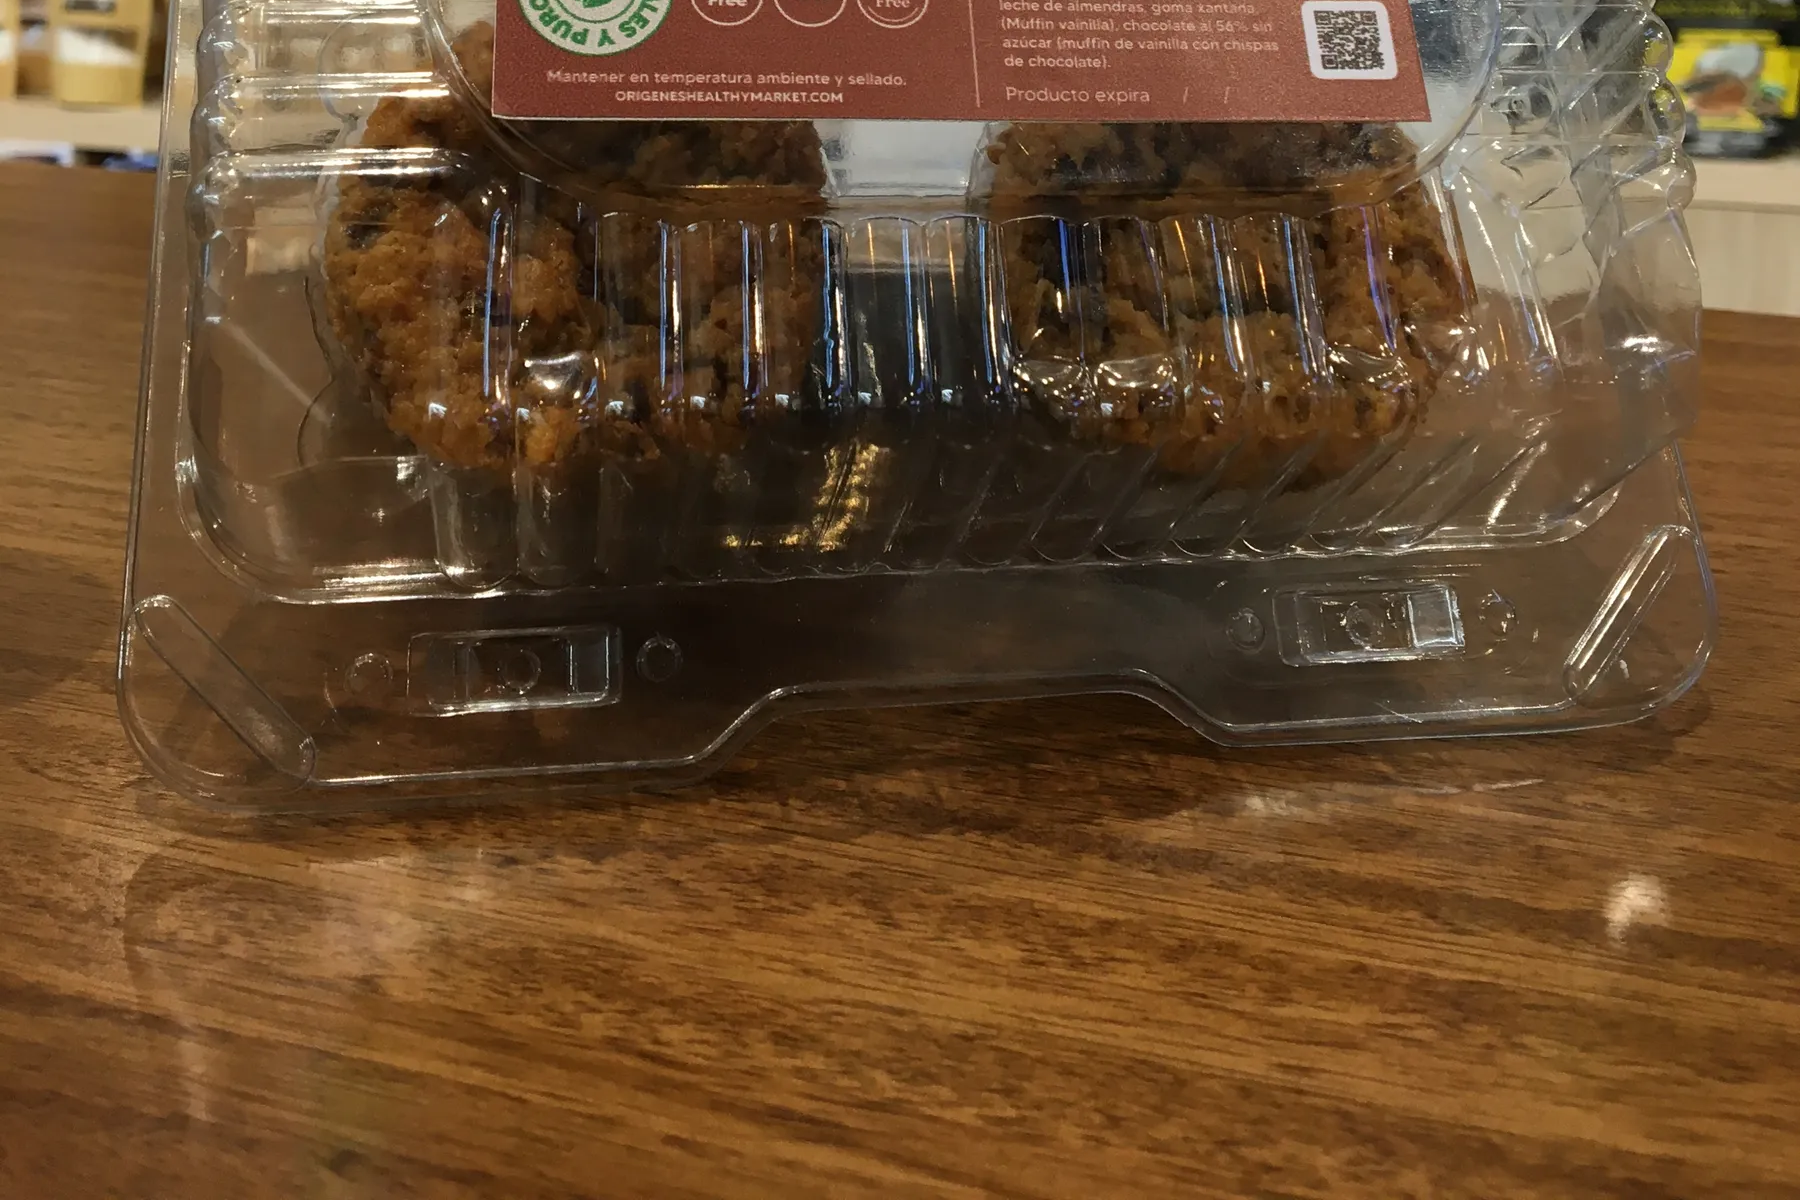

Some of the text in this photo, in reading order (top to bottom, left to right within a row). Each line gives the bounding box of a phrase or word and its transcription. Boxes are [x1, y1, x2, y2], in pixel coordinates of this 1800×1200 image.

[999, 0, 1040, 12] leche
[1043, 0, 1063, 12] de
[1151, 4, 1193, 16] goma
[1001, 17, 1054, 31] (Muffin
[1122, 19, 1196, 32] chocolate
[597, 28, 616, 48] Y
[1002, 36, 1279, 53] azúcar (muffin de vainilla con chispas
[1004, 55, 1112, 70] de chocolate).
[547, 69, 907, 88] Mantener en temperatura ambiente y sellado.
[614, 90, 844, 104] ORIGENESHEALTHYMARKET.COM
[1006, 86, 1091, 102] Producto
[1094, 88, 1150, 105] expira
